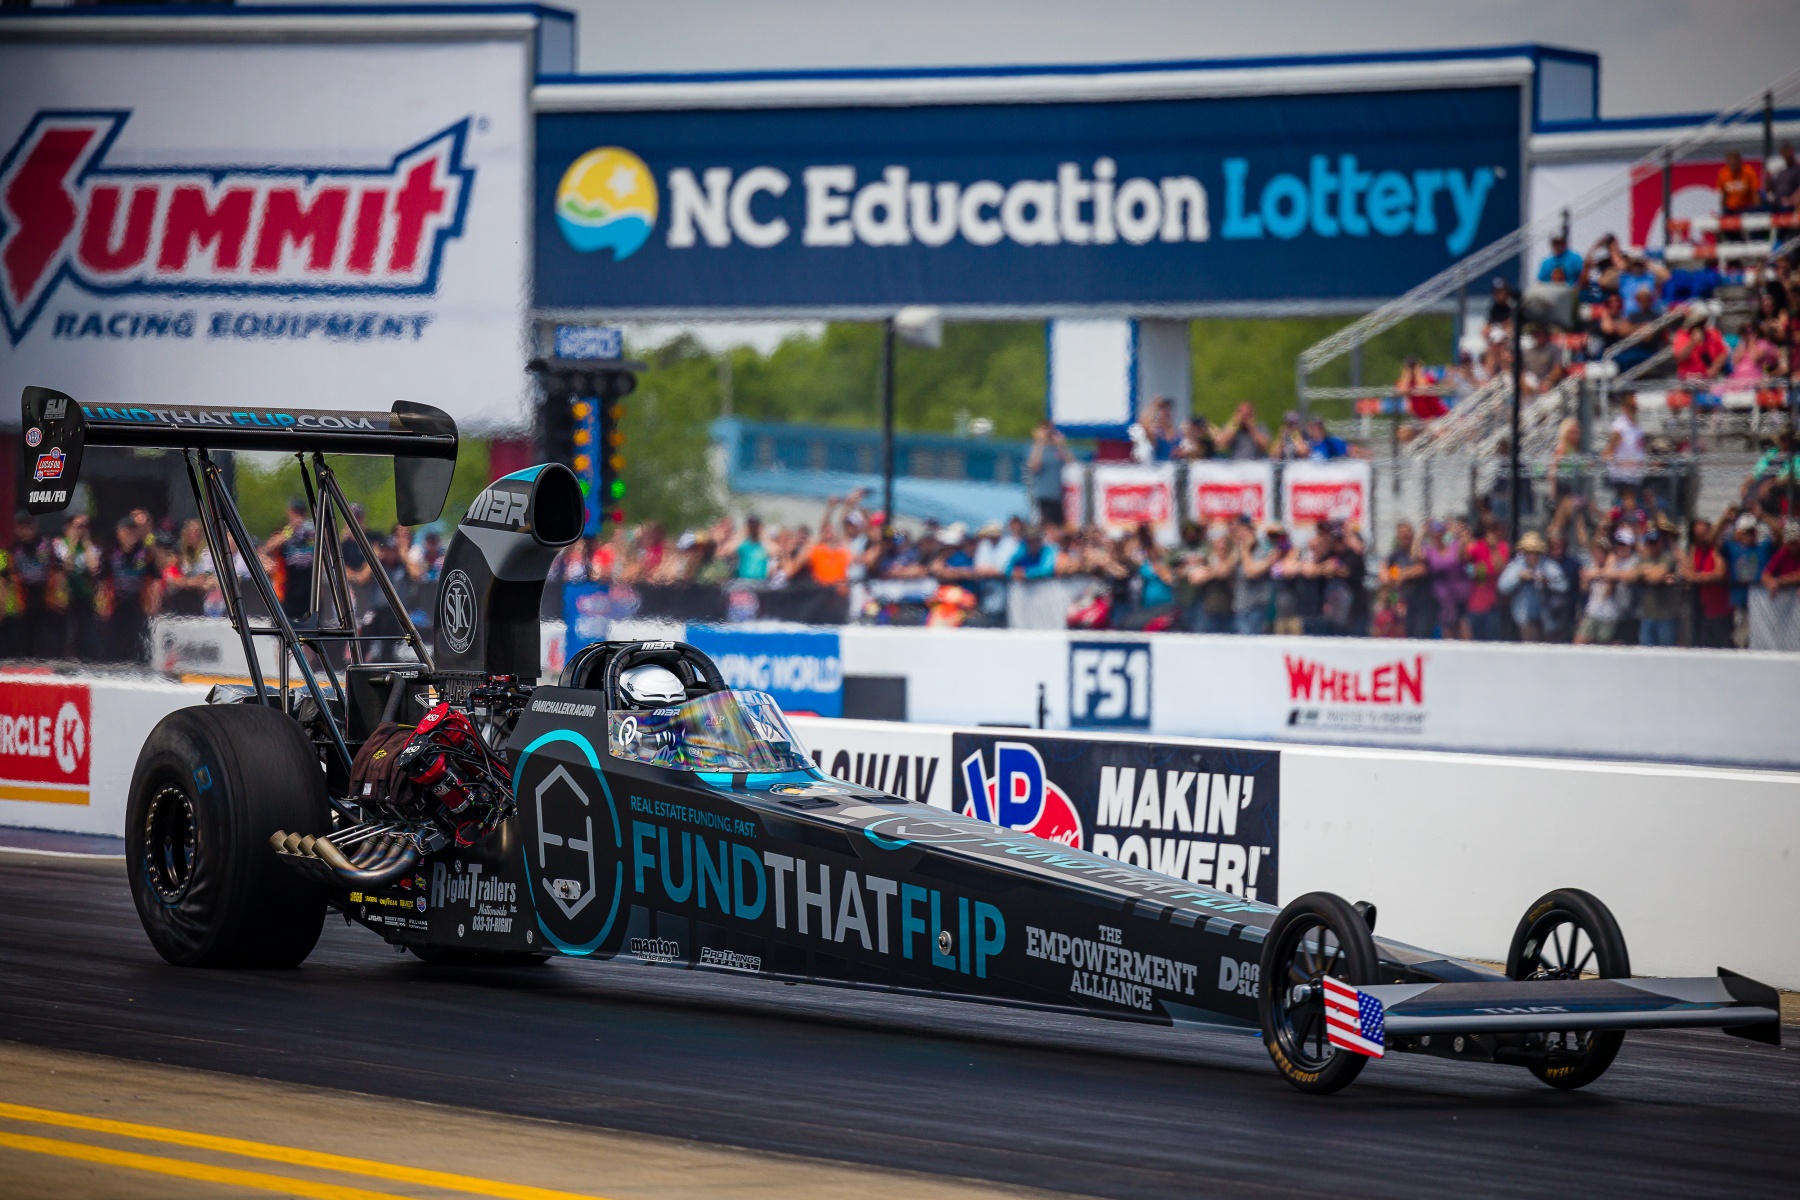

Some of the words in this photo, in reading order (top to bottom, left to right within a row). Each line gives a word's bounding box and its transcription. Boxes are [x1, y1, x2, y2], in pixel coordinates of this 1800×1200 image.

[667, 166, 790, 248] NC
[803, 157, 1209, 247] Education
[1221, 154, 1495, 256] Lottery
[52, 310, 196, 339] RACING
[207, 310, 434, 340] EQUIPMENT
[82, 406, 375, 430] UNDTHATFLIP.COM
[1072, 648, 1151, 720] FS1
[1284, 652, 1424, 706] WHELEN
[532, 700, 597, 717] @MICHALEKRACING
[0, 713, 52, 758] RCLE
[630, 795, 654, 815] REAL
[655, 800, 687, 822] ESTATE
[688, 807, 733, 833] FUNDING.
[734, 819, 757, 839] FAST.
[1096, 766, 1255, 836] MAKIN'
[477, 903, 508, 916] Nationwide
[630, 937, 679, 957] manton
[1098, 925, 1123, 945] THE
[1026, 926, 1198, 996] EMPOWERMENT
[1070, 970, 1153, 1011] ALLIANCE
